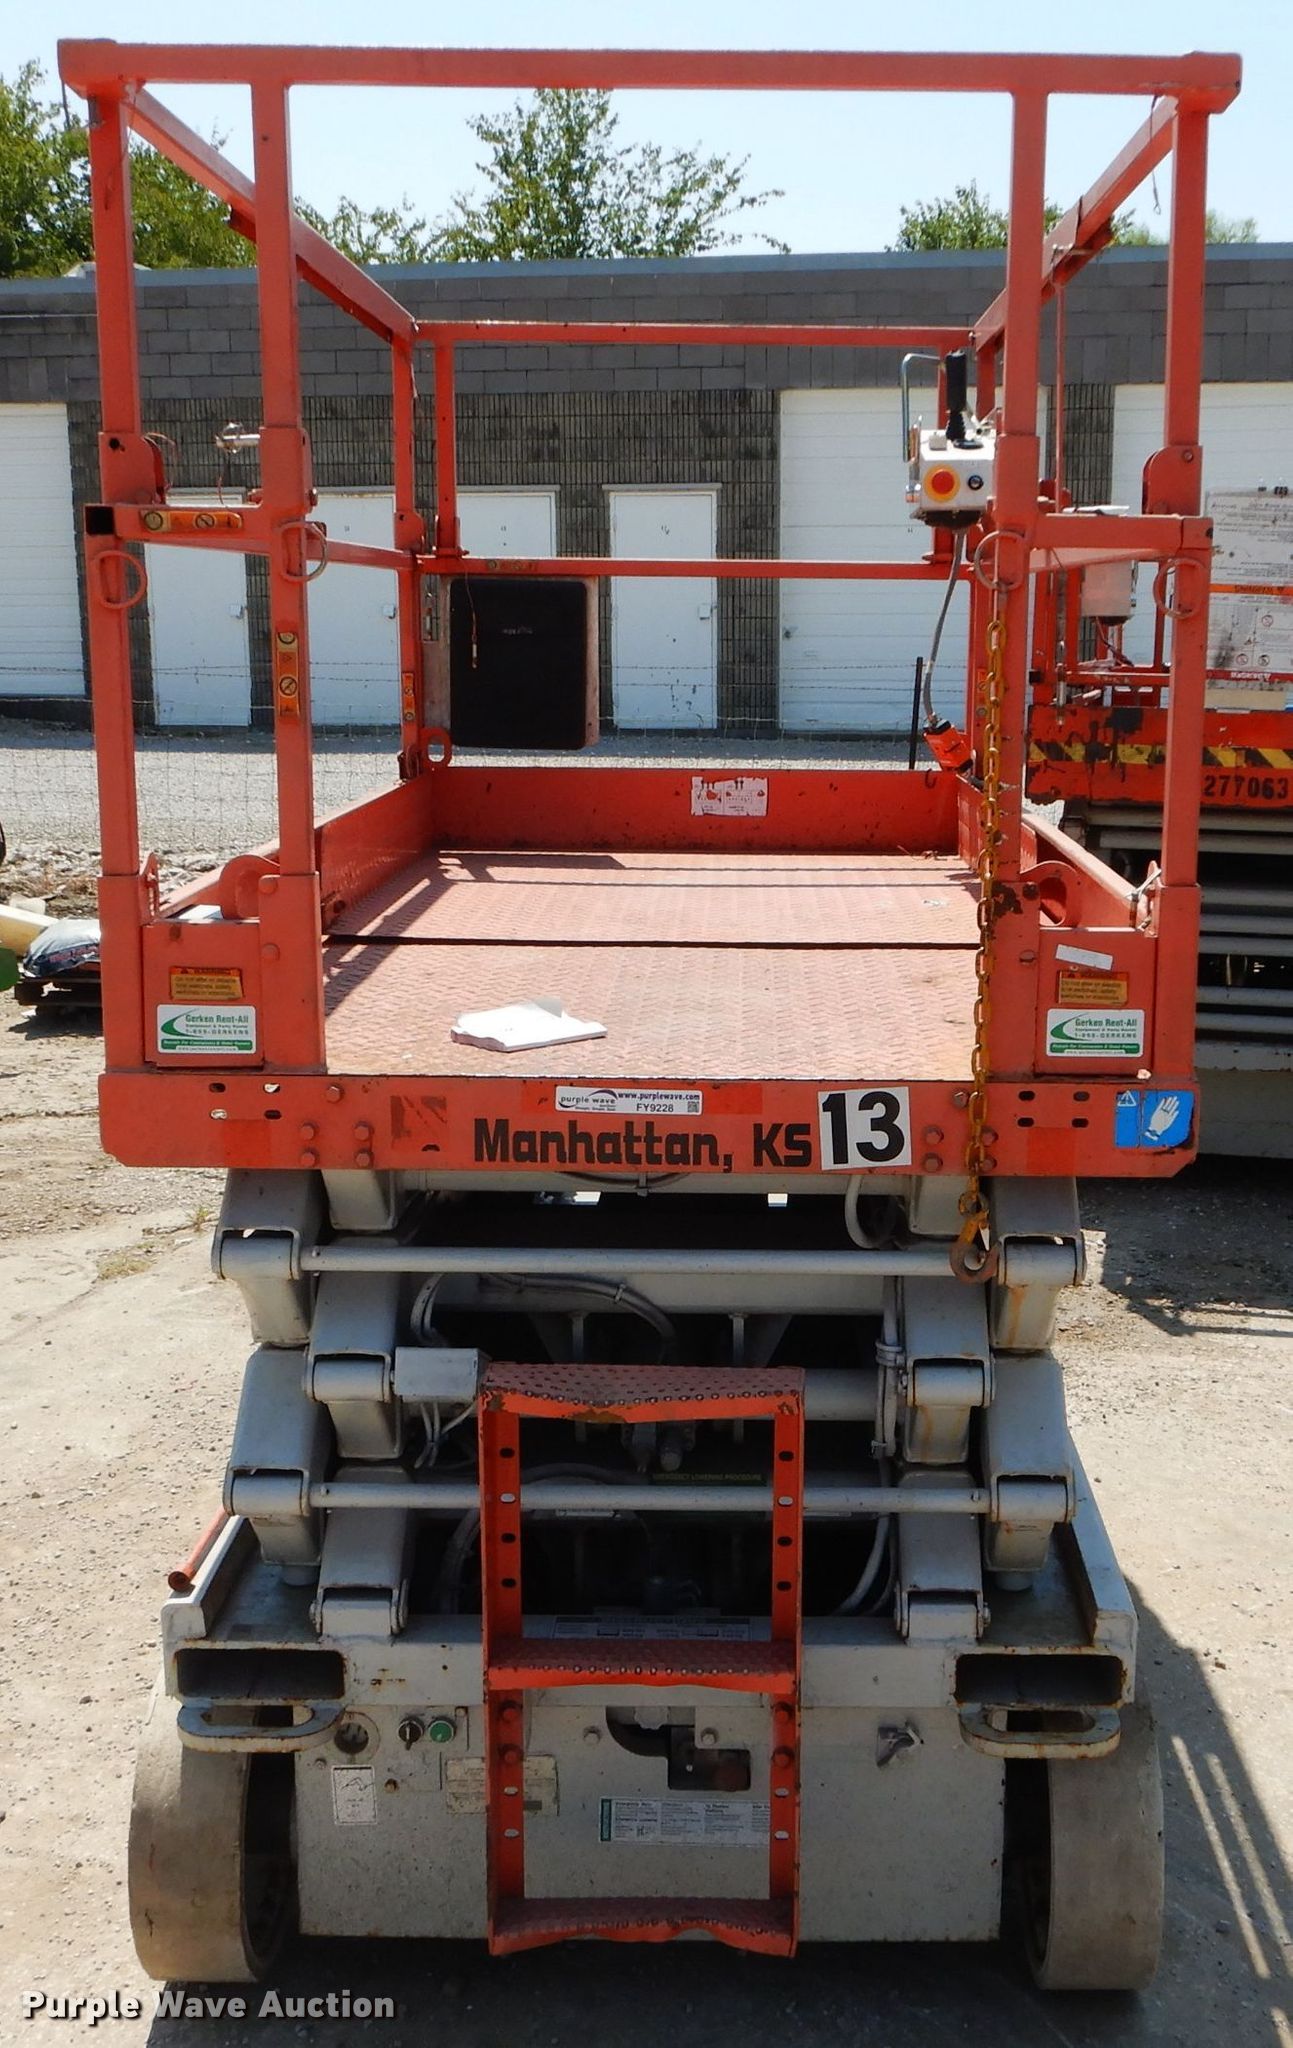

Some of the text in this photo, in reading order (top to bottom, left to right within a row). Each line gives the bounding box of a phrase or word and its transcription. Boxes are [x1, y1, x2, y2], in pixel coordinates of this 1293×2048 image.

[1203, 775, 1289, 799] 277063
[216, 1015, 248, 1023] Rent-All
[1075, 1018, 1137, 1026] Gerken Rent-All
[561, 1096, 589, 1104] purple
[618, 1092, 700, 1100] www.purplewave.com
[636, 1103, 674, 1113] FY9228
[822, 1091, 906, 1166] 13
[475, 1119, 812, 1173] Manhattan, KS
